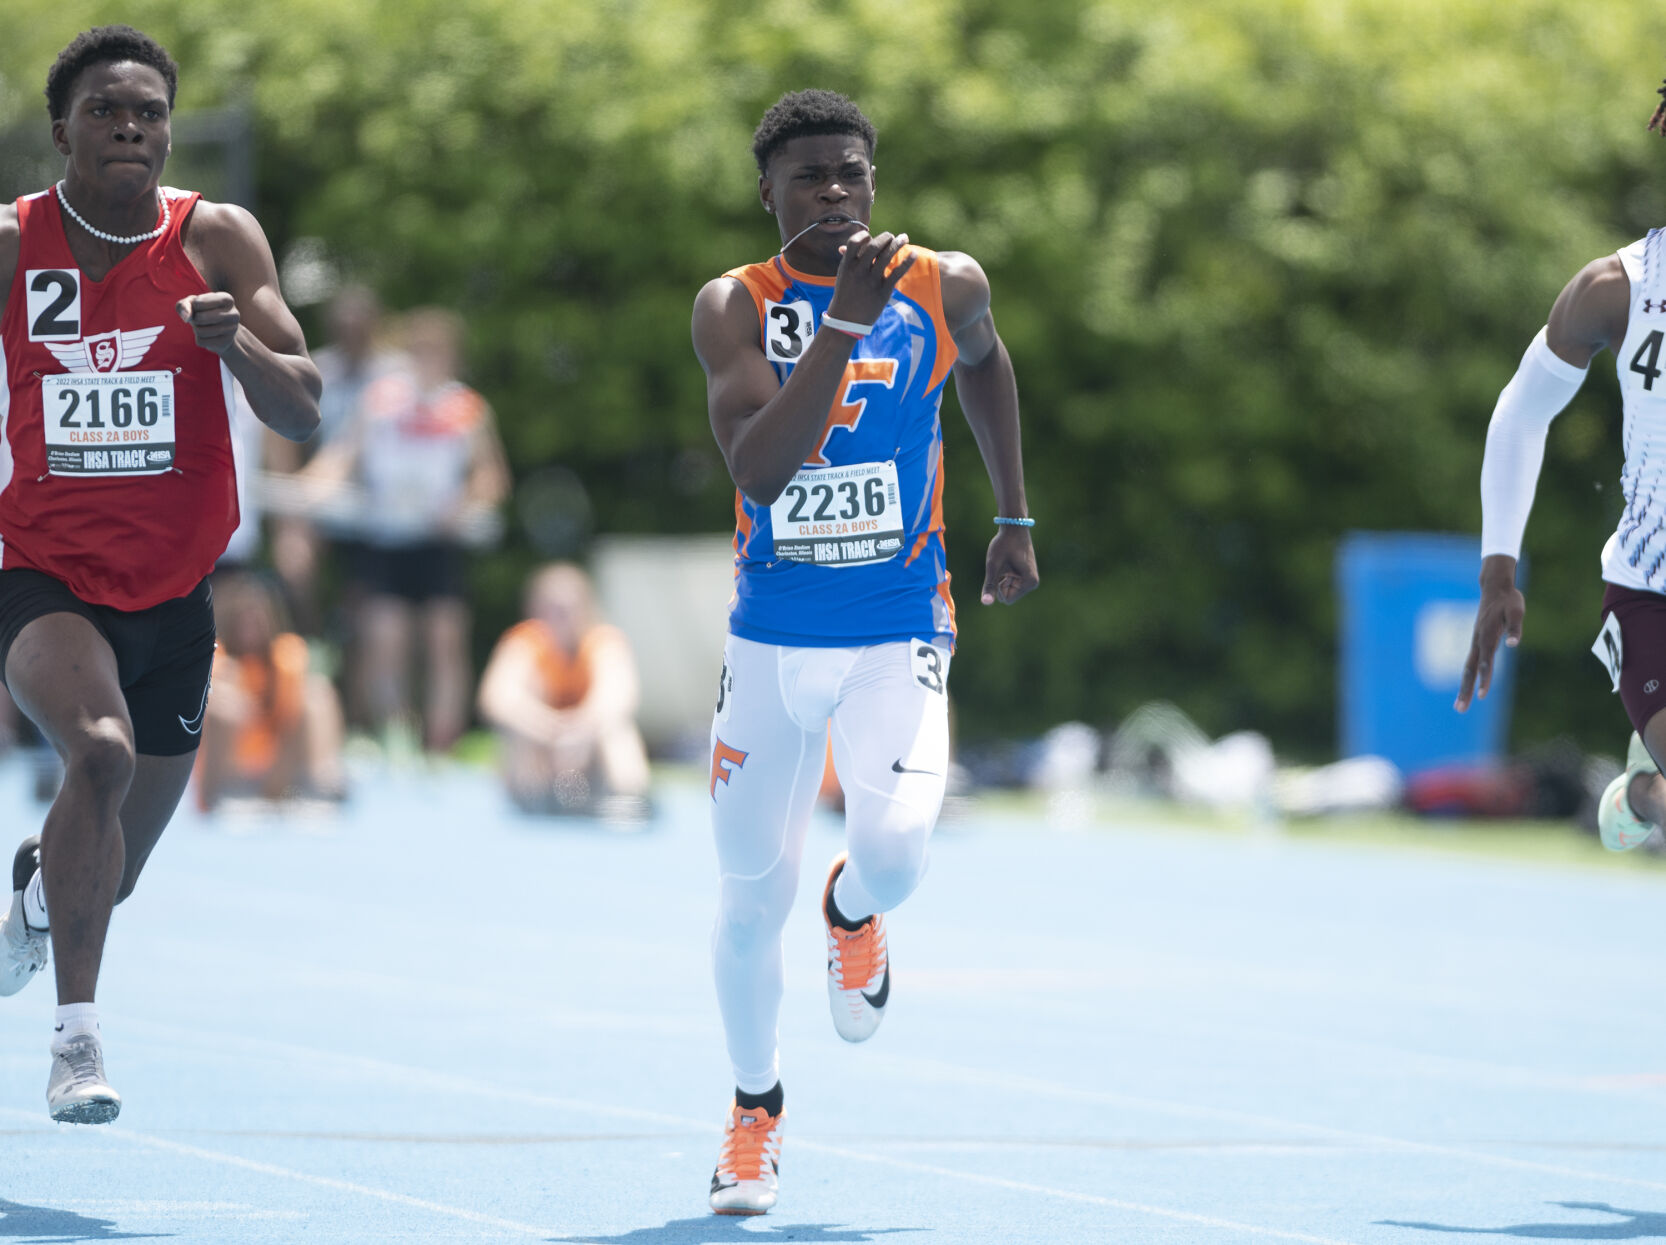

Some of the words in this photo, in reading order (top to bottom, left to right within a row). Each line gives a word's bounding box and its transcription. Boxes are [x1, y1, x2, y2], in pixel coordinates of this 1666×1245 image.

[31, 270, 79, 336] 2
[770, 306, 803, 359] 3
[85, 377, 100, 385] STATE
[101, 377, 119, 385] TRACK
[119, 377, 124, 385] &
[124, 376, 140, 384] FIELD
[141, 376, 156, 384] MEET
[1630, 329, 1665, 392] 4
[58, 387, 158, 428] 2166
[802, 358, 899, 467] F
[69, 431, 103, 443] CLASS
[106, 431, 120, 442] 2A
[123, 430, 150, 441] BOYS
[83, 450, 110, 469] IHSA
[110, 449, 147, 468] TRACK
[811, 473, 826, 481] STATE
[827, 471, 844, 480] TRACK
[844, 471, 849, 479] &
[850, 469, 866, 477] FIELD
[866, 466, 880, 475] MEET
[785, 477, 885, 523] 2236
[799, 523, 833, 536] CLASS
[836, 522, 850, 534] 2A
[851, 519, 878, 532] BOYS
[814, 542, 841, 561] IHSA
[841, 539, 877, 560] TRACK
[917, 645, 943, 695] 3
[710, 735, 750, 803] F
